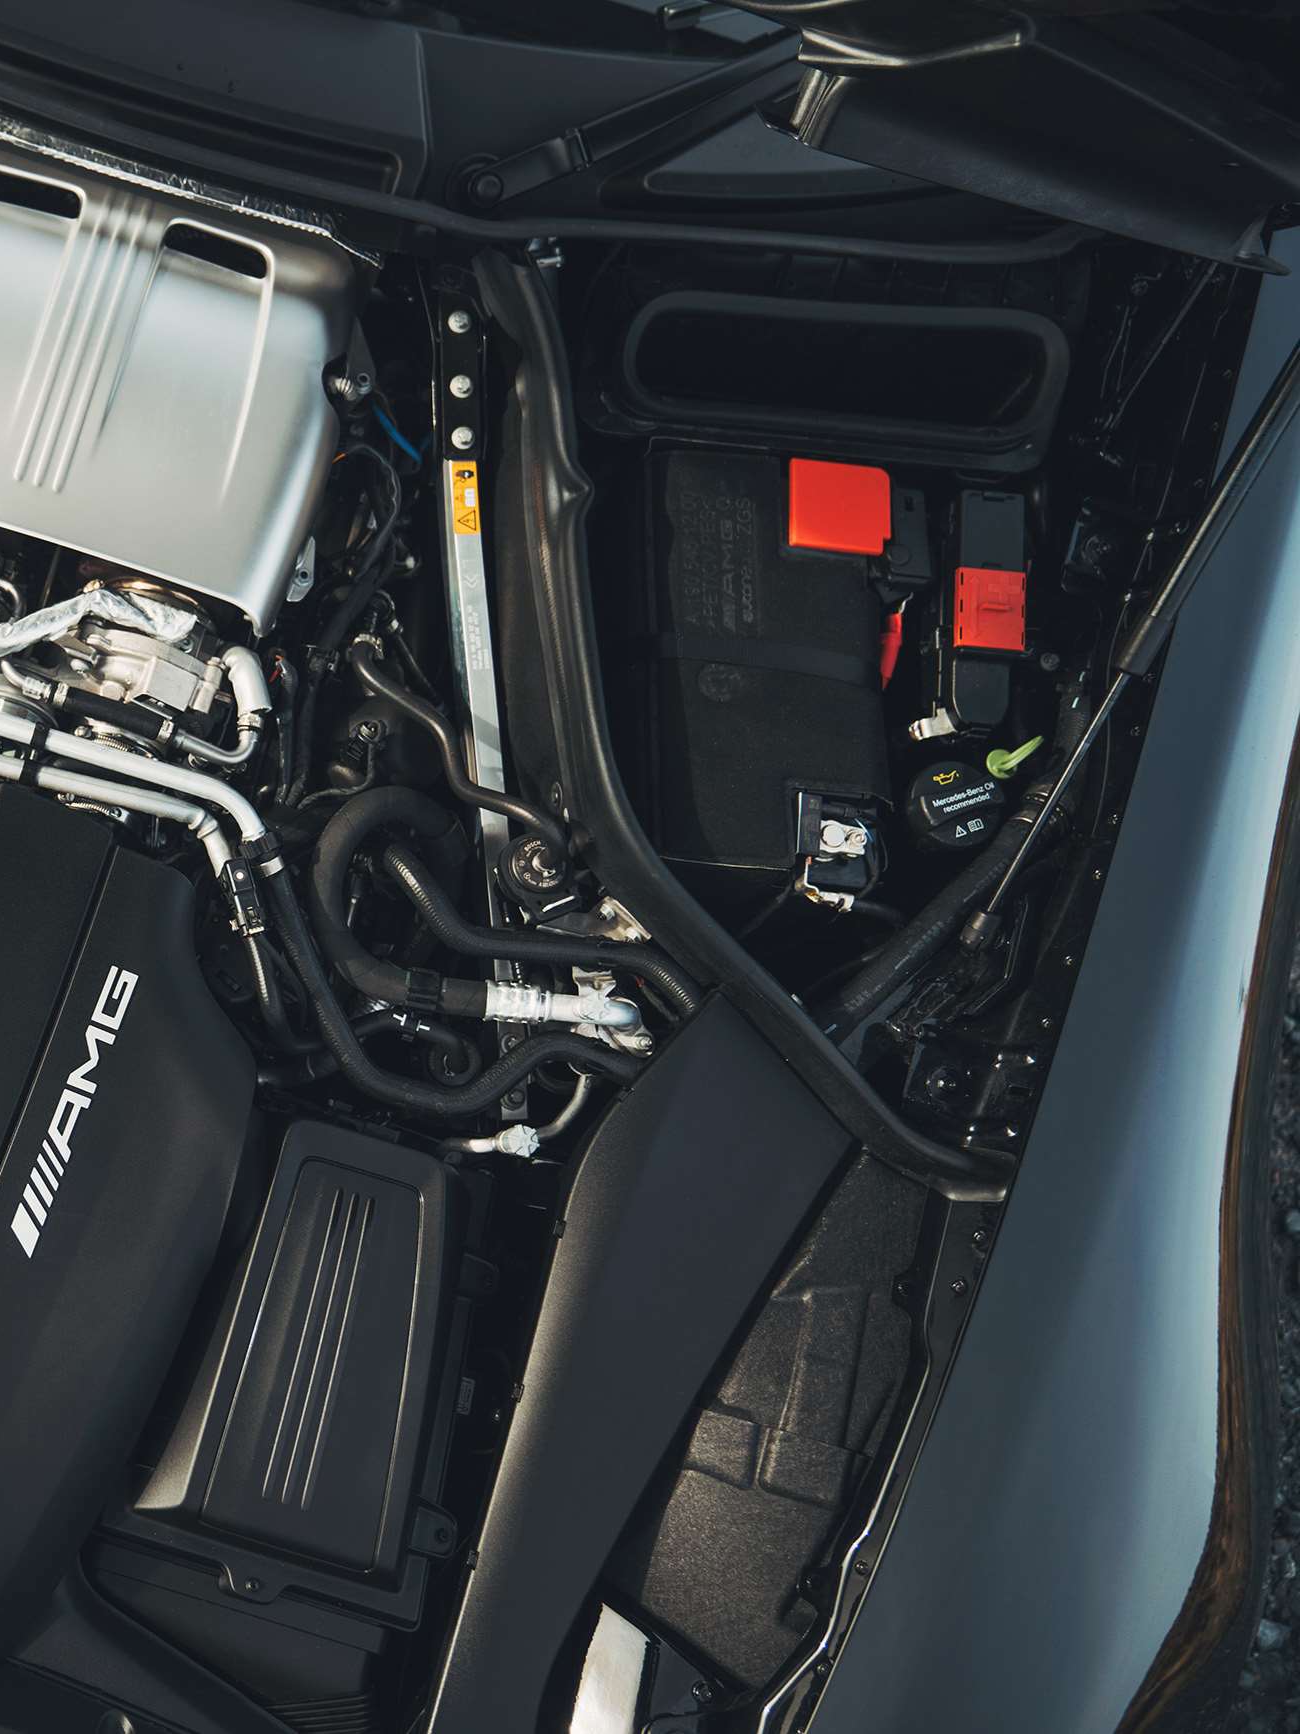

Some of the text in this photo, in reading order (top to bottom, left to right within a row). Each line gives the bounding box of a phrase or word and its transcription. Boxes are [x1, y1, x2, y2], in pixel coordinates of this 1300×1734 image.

[932, 782, 996, 808] Mercedes-Benz Oil
[943, 792, 991, 814] recommended
[47, 965, 139, 1164] AMG
